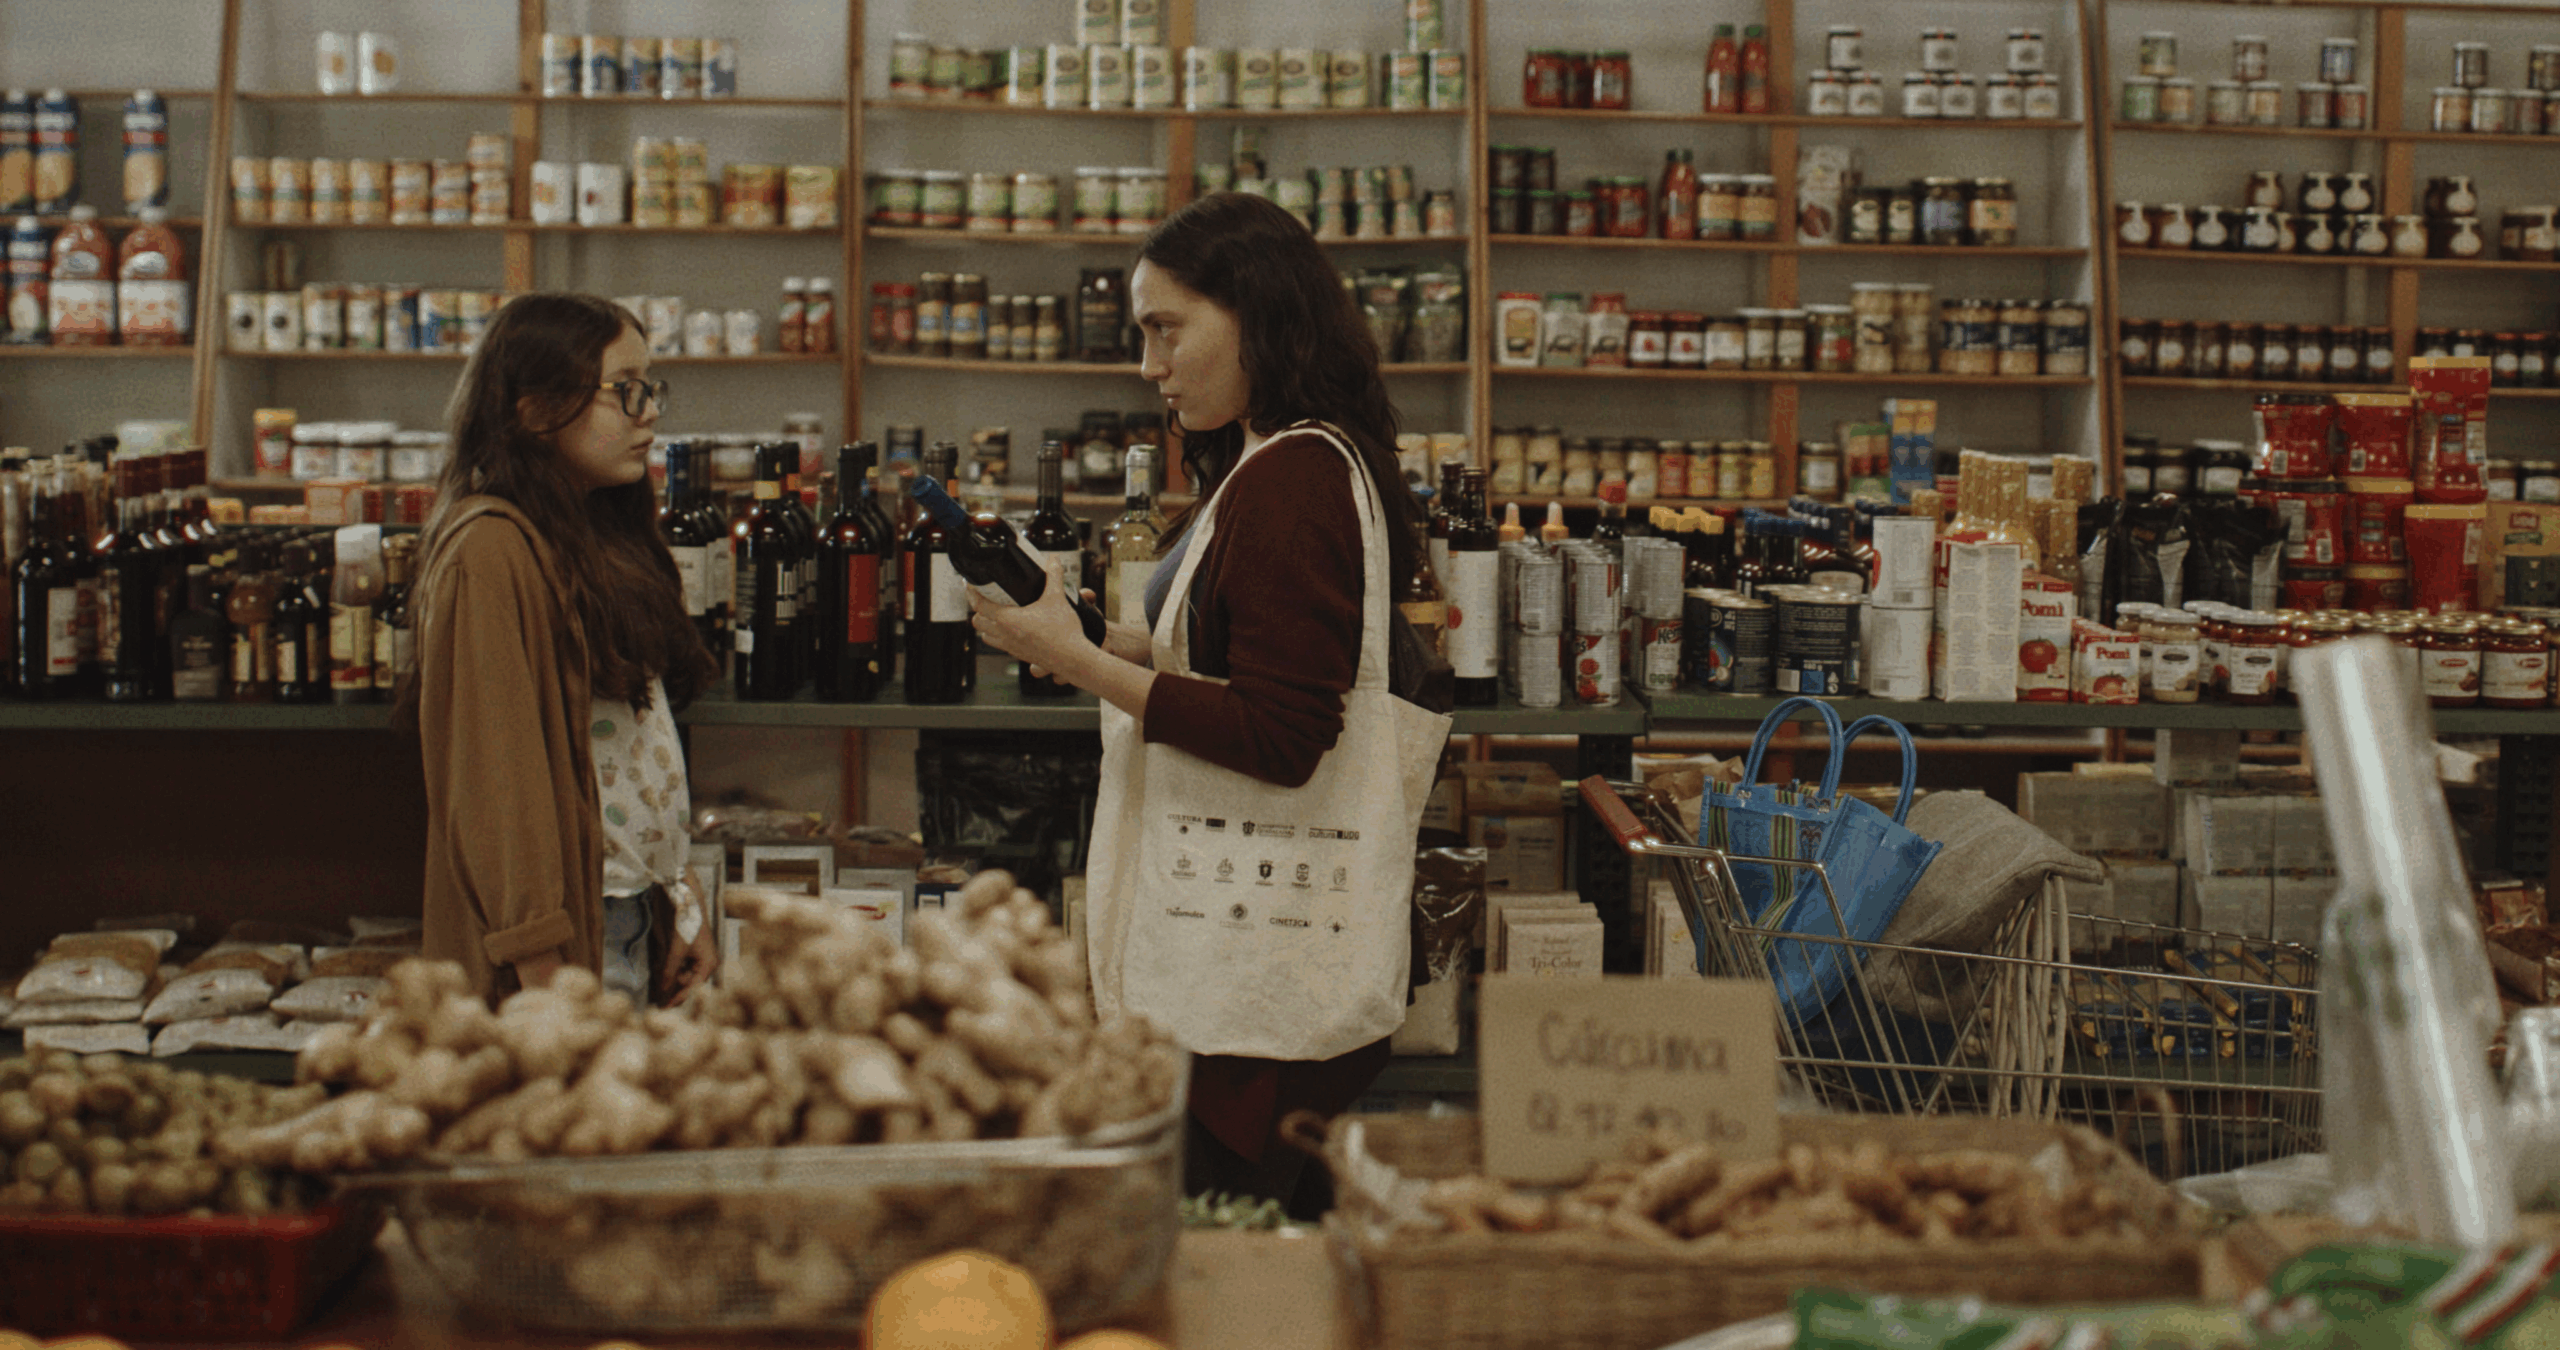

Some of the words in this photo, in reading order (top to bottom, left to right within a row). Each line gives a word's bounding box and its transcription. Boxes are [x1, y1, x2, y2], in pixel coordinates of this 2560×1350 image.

[1167, 813, 1202, 822] CULTURA
[1343, 830, 1360, 841] UDG
[1530, 956, 1582, 969] Tri-Color
